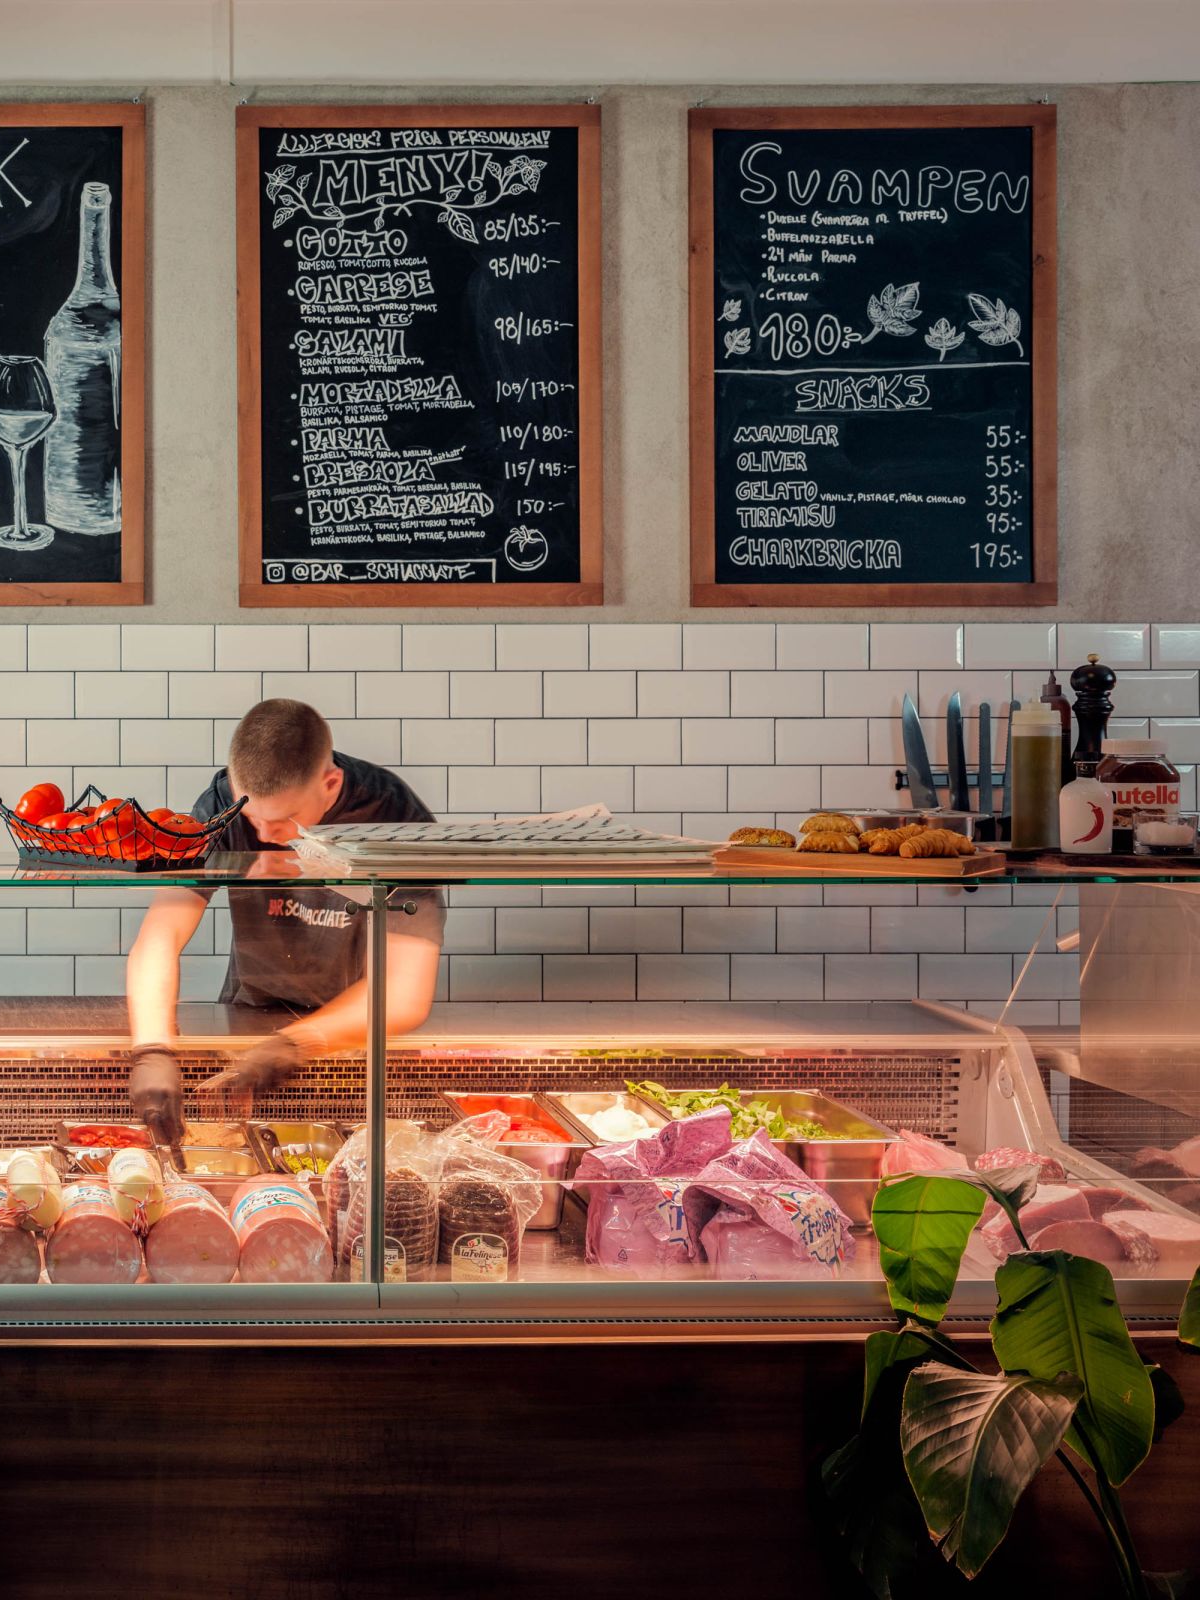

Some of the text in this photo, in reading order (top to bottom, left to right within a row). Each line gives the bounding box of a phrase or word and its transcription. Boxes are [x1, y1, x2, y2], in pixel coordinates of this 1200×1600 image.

[278, 130, 382, 153] ALLERGISK?
[391, 130, 442, 149] FRÅGA
[312, 150, 492, 207] MENY!
[740, 141, 1029, 214] SVAMPEN
[296, 226, 408, 260] COTTO
[768, 247, 784, 262] 24
[295, 270, 435, 303] CAPRESE
[295, 329, 406, 357] SALAMI
[299, 375, 462, 406] MORTADELLA
[795, 374, 931, 410] SNACKS
[302, 427, 390, 453] PARMA
[734, 425, 839, 446] MANDLAR
[304, 459, 435, 488] BRESAOLA
[737, 451, 807, 472] OLIVER
[736, 481, 818, 502] GELATO
[737, 504, 835, 528] TIRAMISU
[729, 536, 901, 569] CHARKBRICKA
[1112, 782, 1179, 805] utella
